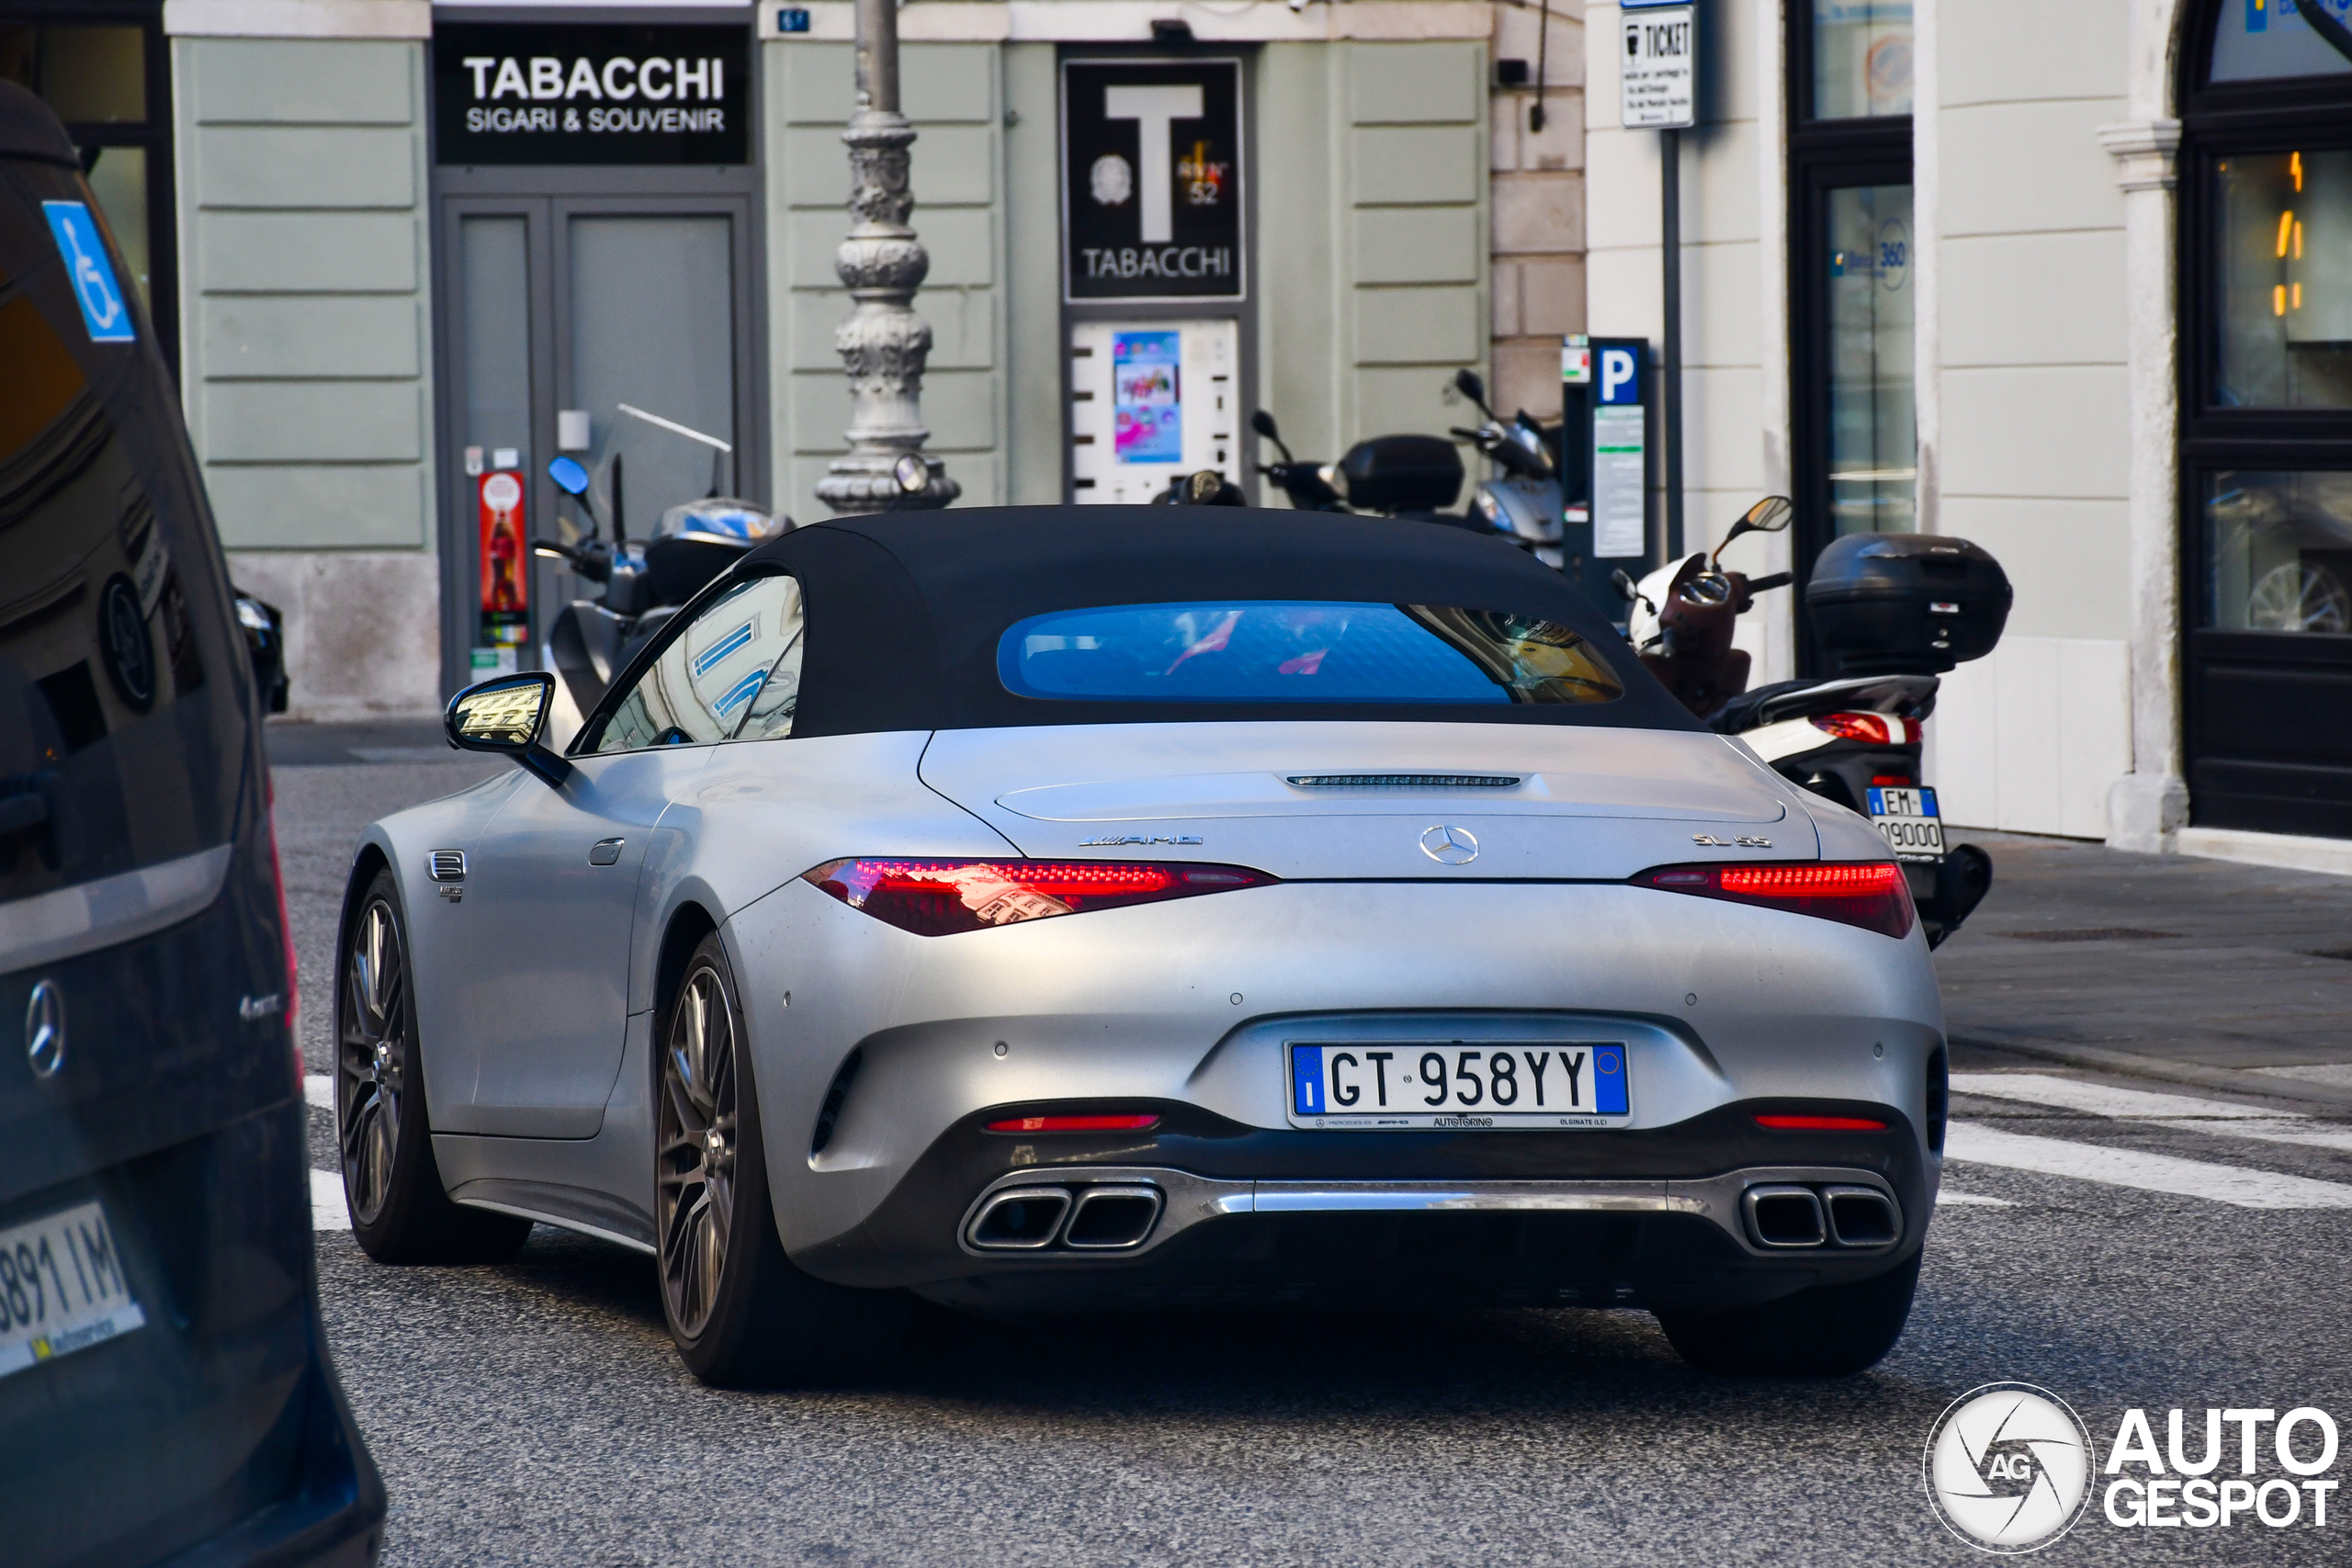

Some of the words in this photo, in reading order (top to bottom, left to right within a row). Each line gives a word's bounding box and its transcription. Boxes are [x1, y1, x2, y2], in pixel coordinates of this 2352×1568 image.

[1645, 22, 1690, 57] TICKET
[462, 56, 724, 100] TABACCHI
[466, 107, 557, 132] SIGARI
[562, 107, 582, 132] &
[587, 107, 726, 132] SOUVENIR
[1104, 85, 1204, 243] T
[1082, 246, 1231, 277] TABACCHI
[1880, 242, 1906, 267] 360
[1602, 349, 1634, 401] P
[1884, 790, 1912, 814] EM
[1117, 835, 1204, 846] AMG
[1691, 833, 1732, 847] SL
[1734, 835, 1773, 849] 55
[1330, 1052, 1394, 1107] GT
[1419, 1051, 1586, 1107] 958YY
[1433, 1117, 1494, 1127] AUTOTORINO
[1559, 1118, 1593, 1126] OLGINATE
[1594, 1118, 1608, 1126] (LC)
